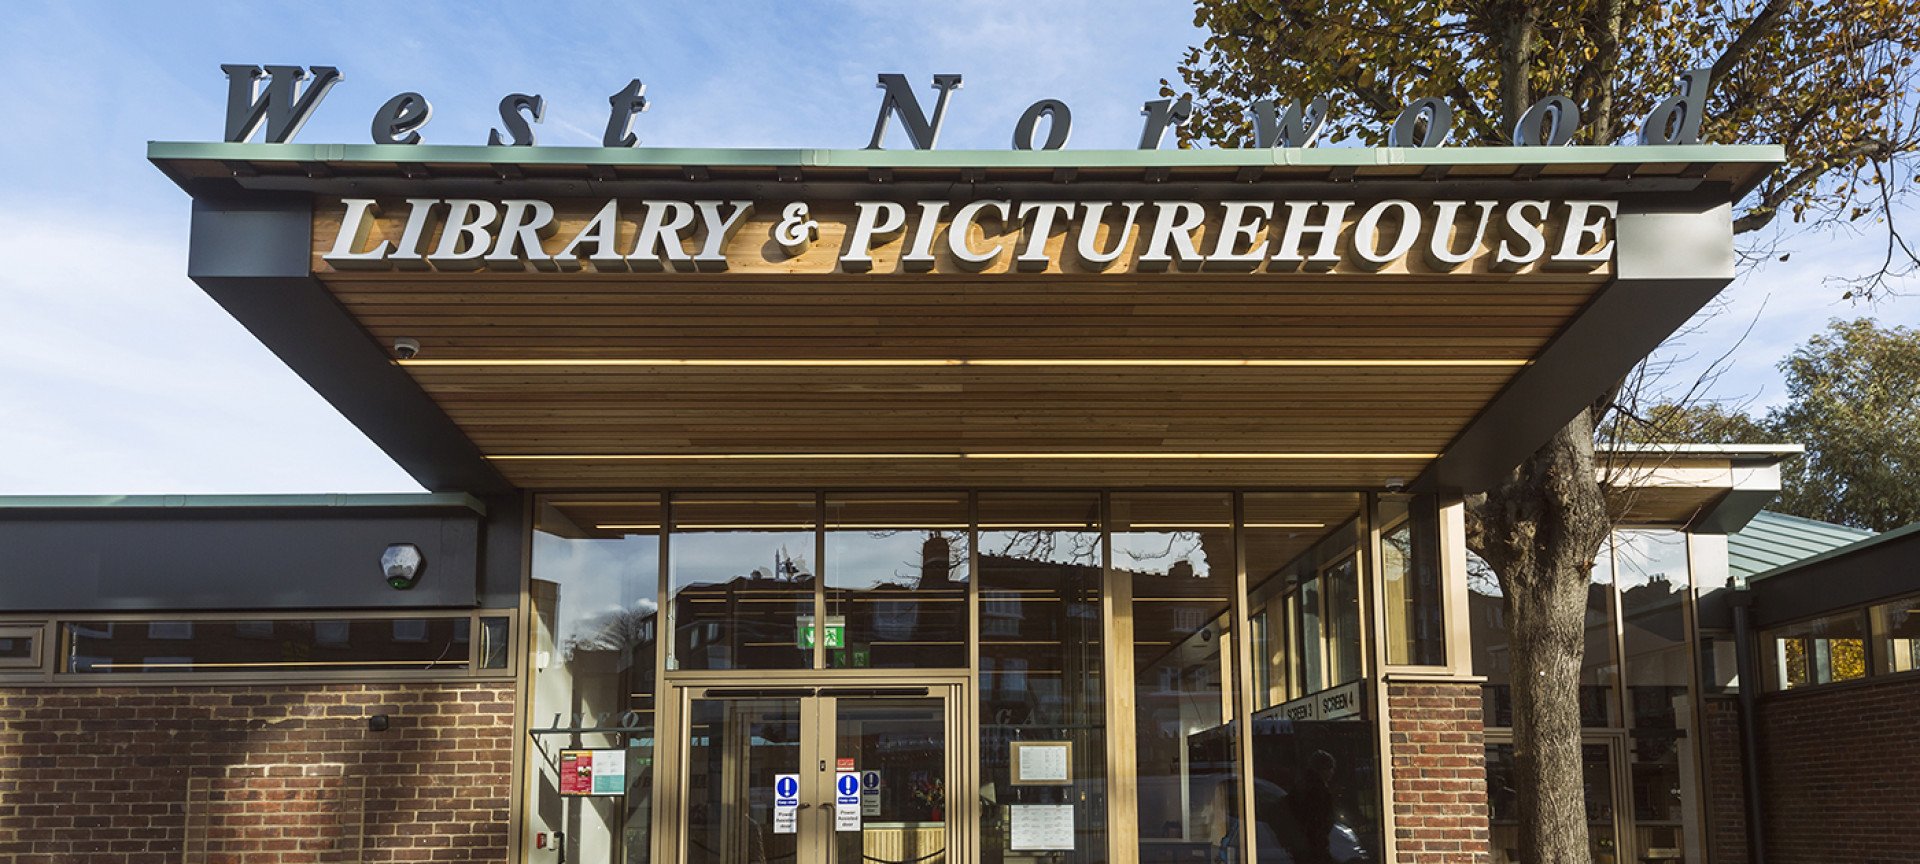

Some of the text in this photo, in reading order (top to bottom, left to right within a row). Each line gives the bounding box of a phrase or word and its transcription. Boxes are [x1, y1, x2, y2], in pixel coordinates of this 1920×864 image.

[221, 64, 1712, 151] West Norwood
[322, 199, 1618, 271] LIBRARY & PICTUREHOUSE
[1323, 690, 1354, 714] SCREEN 4
